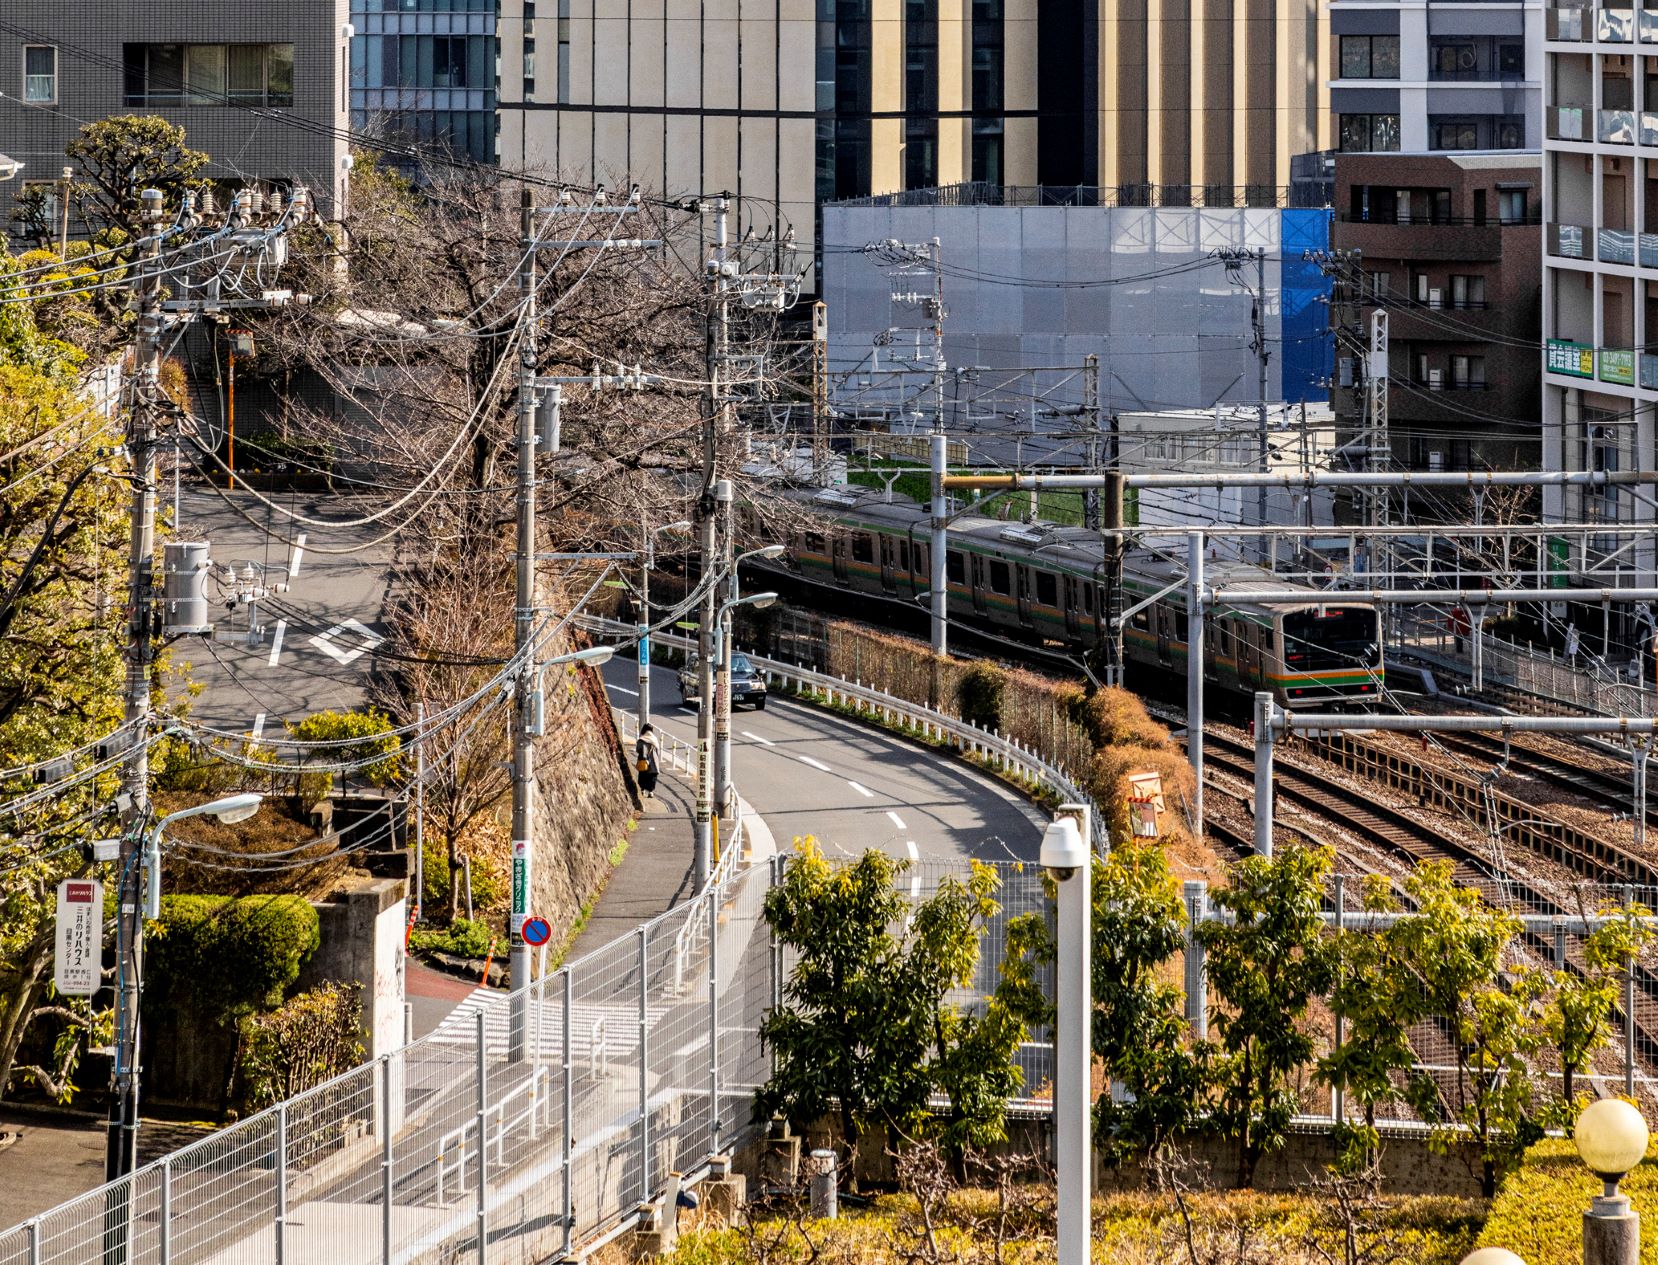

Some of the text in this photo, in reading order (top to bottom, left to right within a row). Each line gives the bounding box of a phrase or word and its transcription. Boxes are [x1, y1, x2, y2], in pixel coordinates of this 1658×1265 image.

[74, 906, 84, 966] 三井のリハウス
